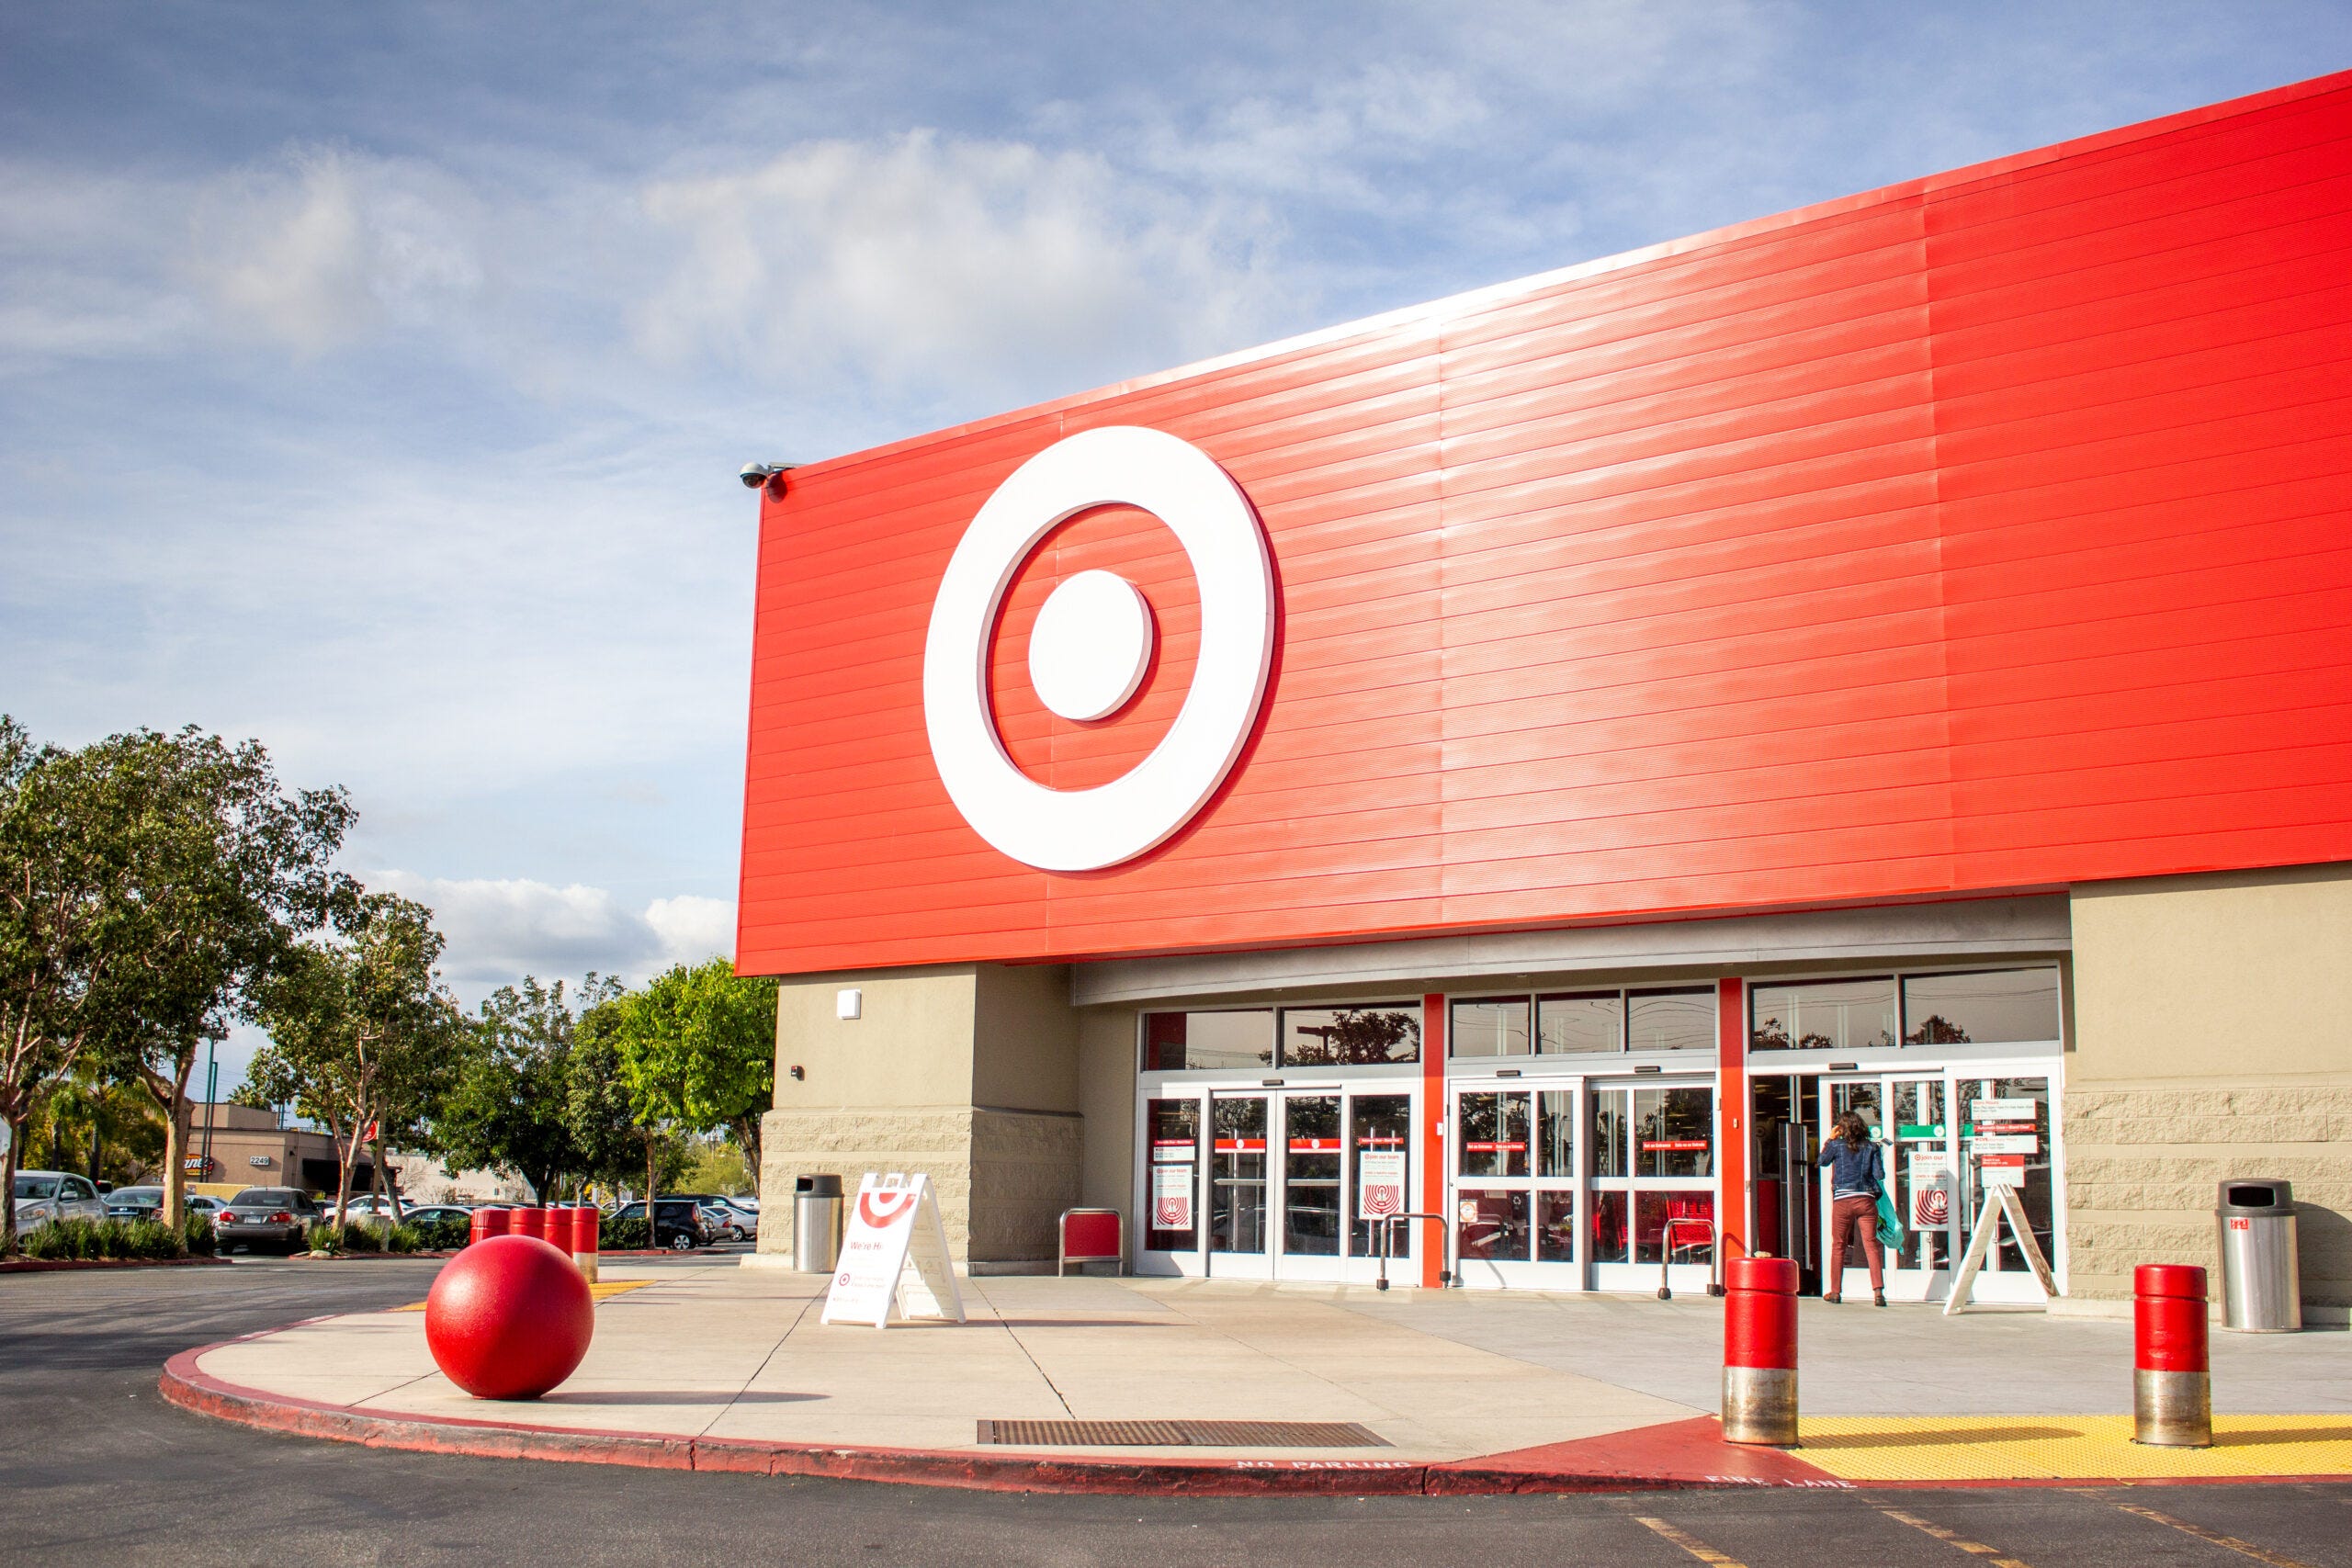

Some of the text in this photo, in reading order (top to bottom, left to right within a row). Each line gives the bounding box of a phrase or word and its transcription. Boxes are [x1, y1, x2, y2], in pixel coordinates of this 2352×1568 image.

[250, 1156, 269, 1165] 2249
[850, 1241, 872, 1250] We're
[1237, 1461, 1411, 1470] NO PARKING
[1704, 1475, 1859, 1488] FIRE LANE
